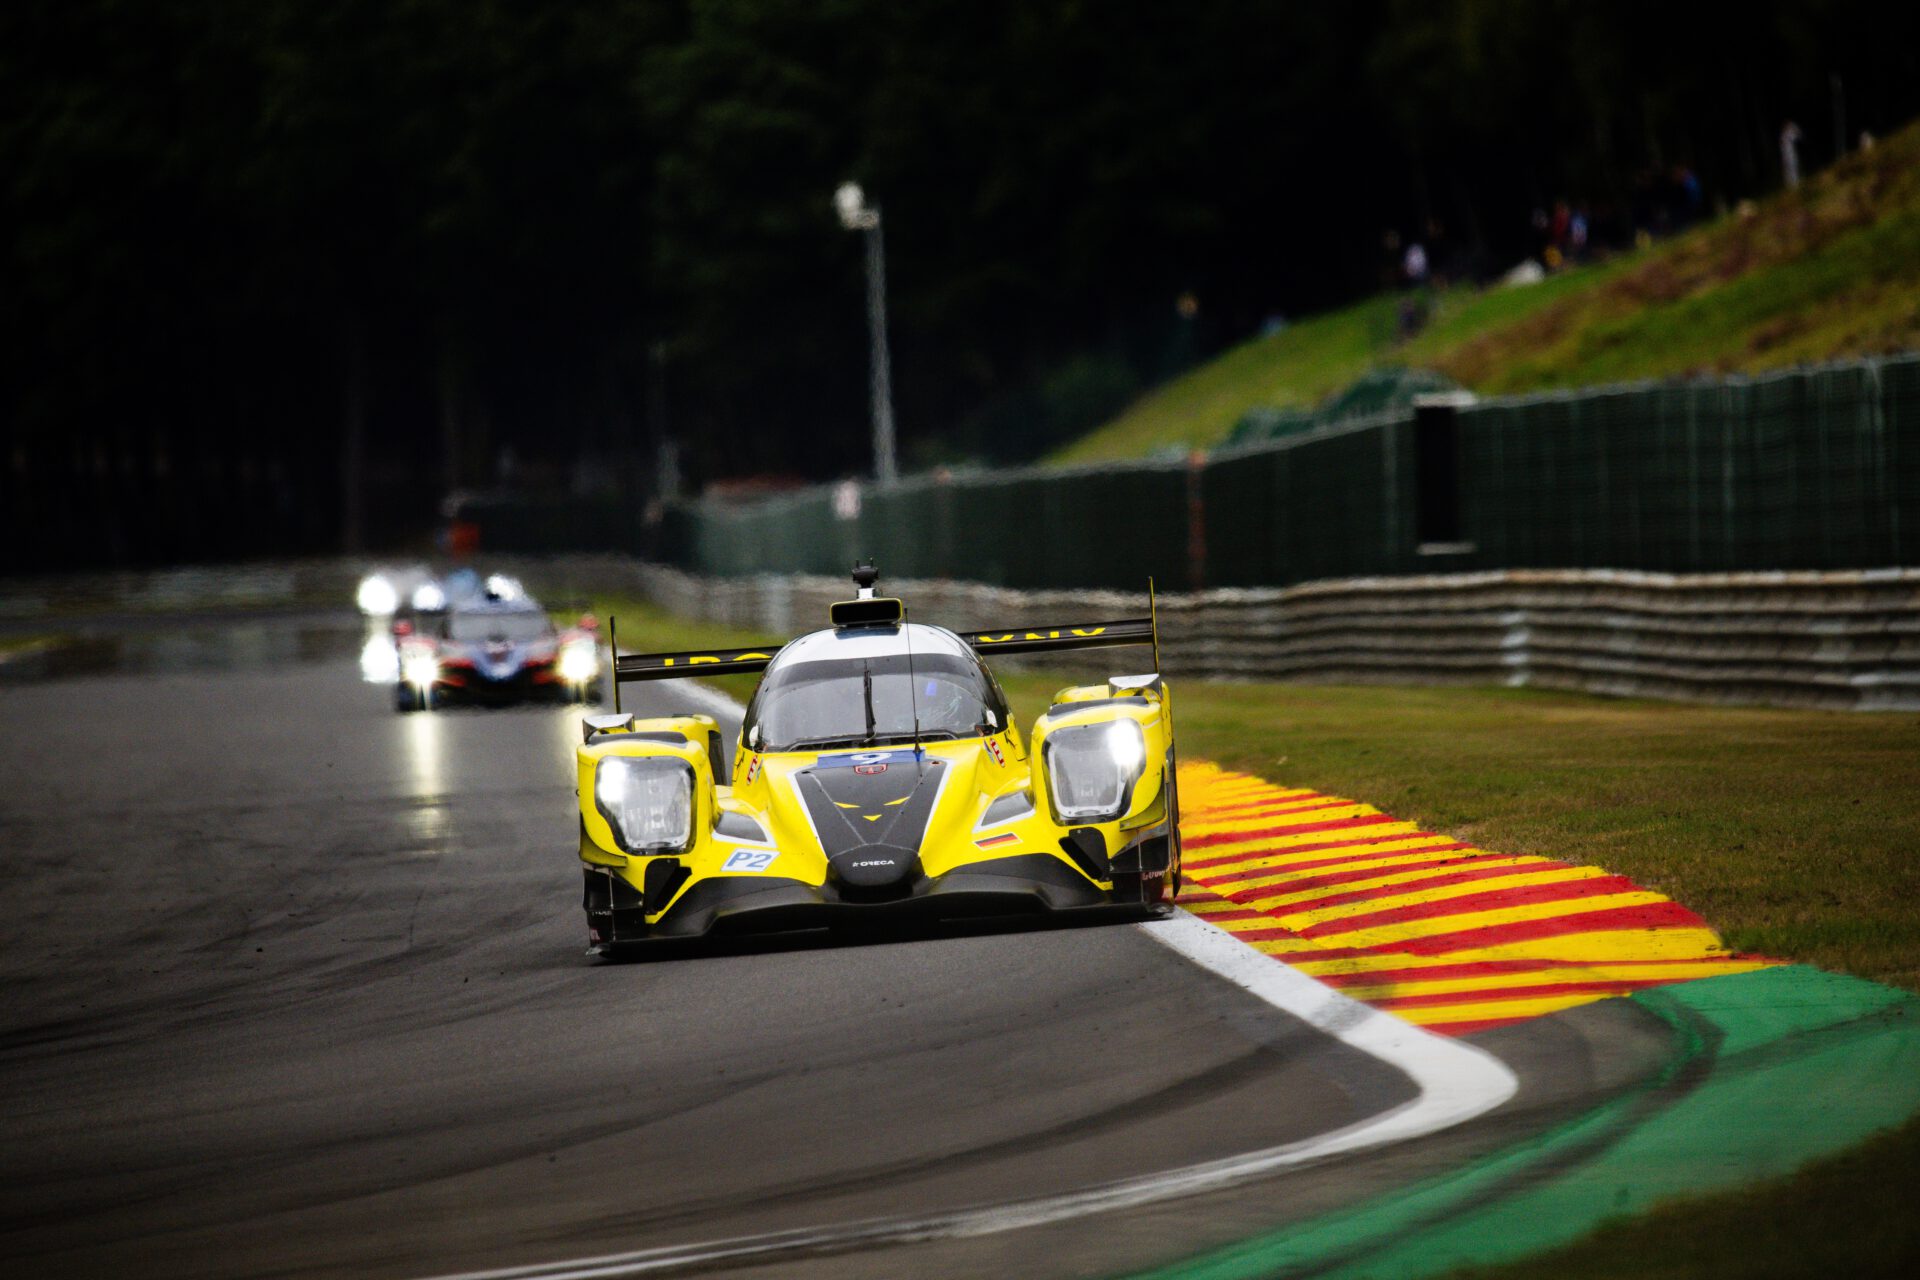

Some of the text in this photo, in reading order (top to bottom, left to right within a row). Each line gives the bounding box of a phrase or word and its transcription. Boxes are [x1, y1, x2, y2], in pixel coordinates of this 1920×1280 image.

[850, 752, 892, 765] 9
[727, 852, 772, 868] P2
[860, 859, 895, 867] ORECA
